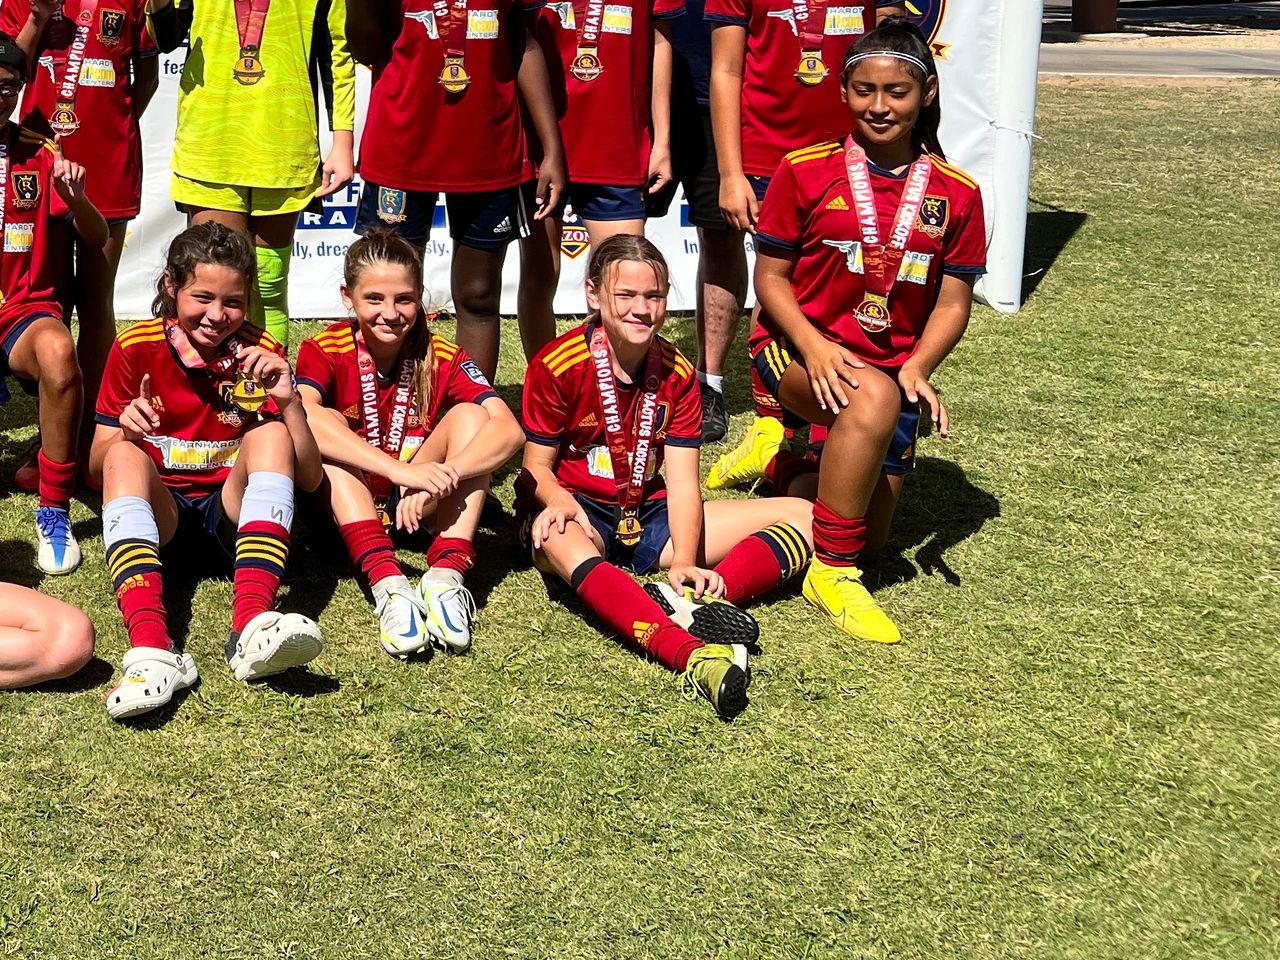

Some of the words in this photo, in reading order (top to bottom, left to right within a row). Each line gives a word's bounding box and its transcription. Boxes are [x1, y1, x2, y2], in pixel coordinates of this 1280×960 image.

[61, 26, 89, 97] CHAMPIONS
[849, 162, 879, 244] CHAMPIONS
[905, 163, 928, 203] CACTUS
[891, 203, 917, 249] KICKOFF
[317, 242, 347, 257] drea
[396, 360, 413, 403] CACTUS
[594, 349, 620, 433] CHAMPIONS
[361, 373, 380, 447] HAMPIONS
[388, 406, 407, 452] KICKOFF
[639, 392, 657, 437] CACTUS
[171, 463, 197, 471] AUTO
[632, 439, 649, 486] KICKOFF
